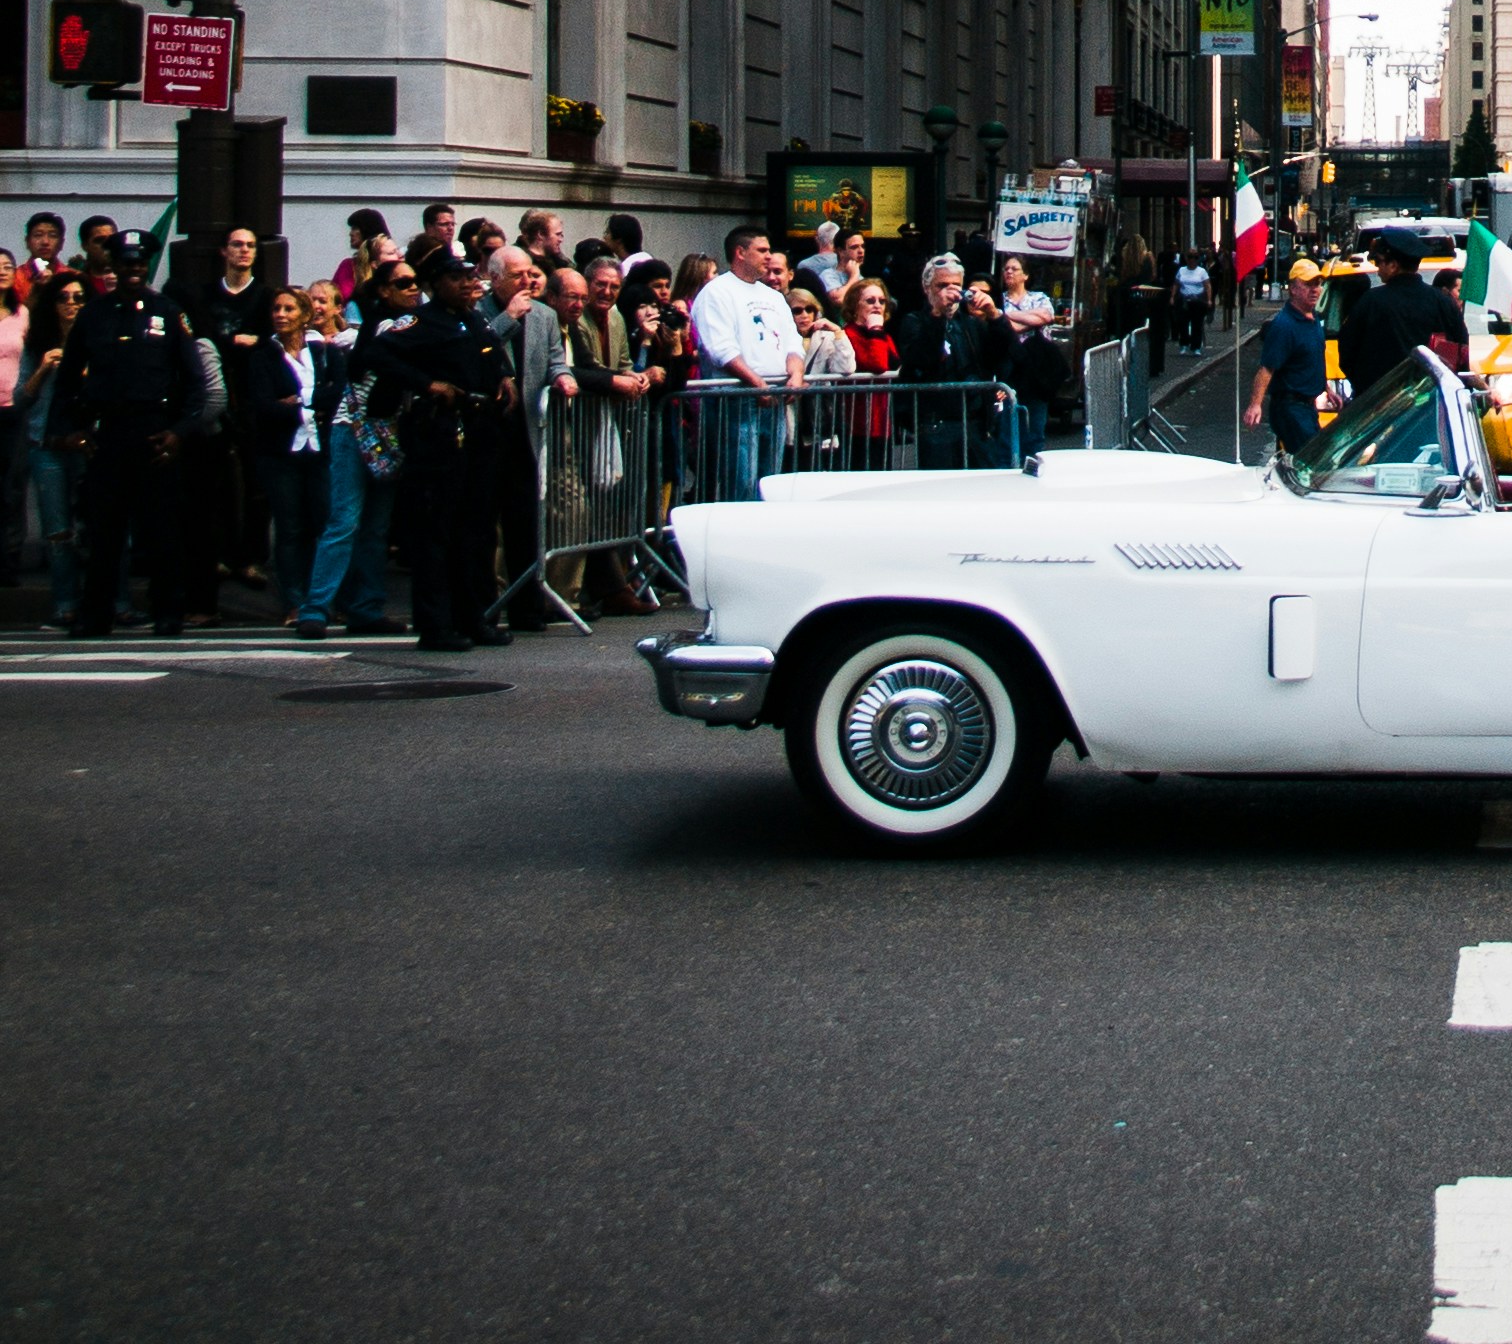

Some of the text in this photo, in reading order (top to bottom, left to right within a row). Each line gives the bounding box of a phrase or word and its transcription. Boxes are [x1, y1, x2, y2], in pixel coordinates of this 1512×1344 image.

[152, 23, 227, 39] NO STANDING
[154, 40, 222, 55] EXCEPT TRUCKS
[159, 54, 202, 66] LOADING
[158, 67, 215, 80] UNLOADING
[1003, 211, 1075, 237] SABRETT
